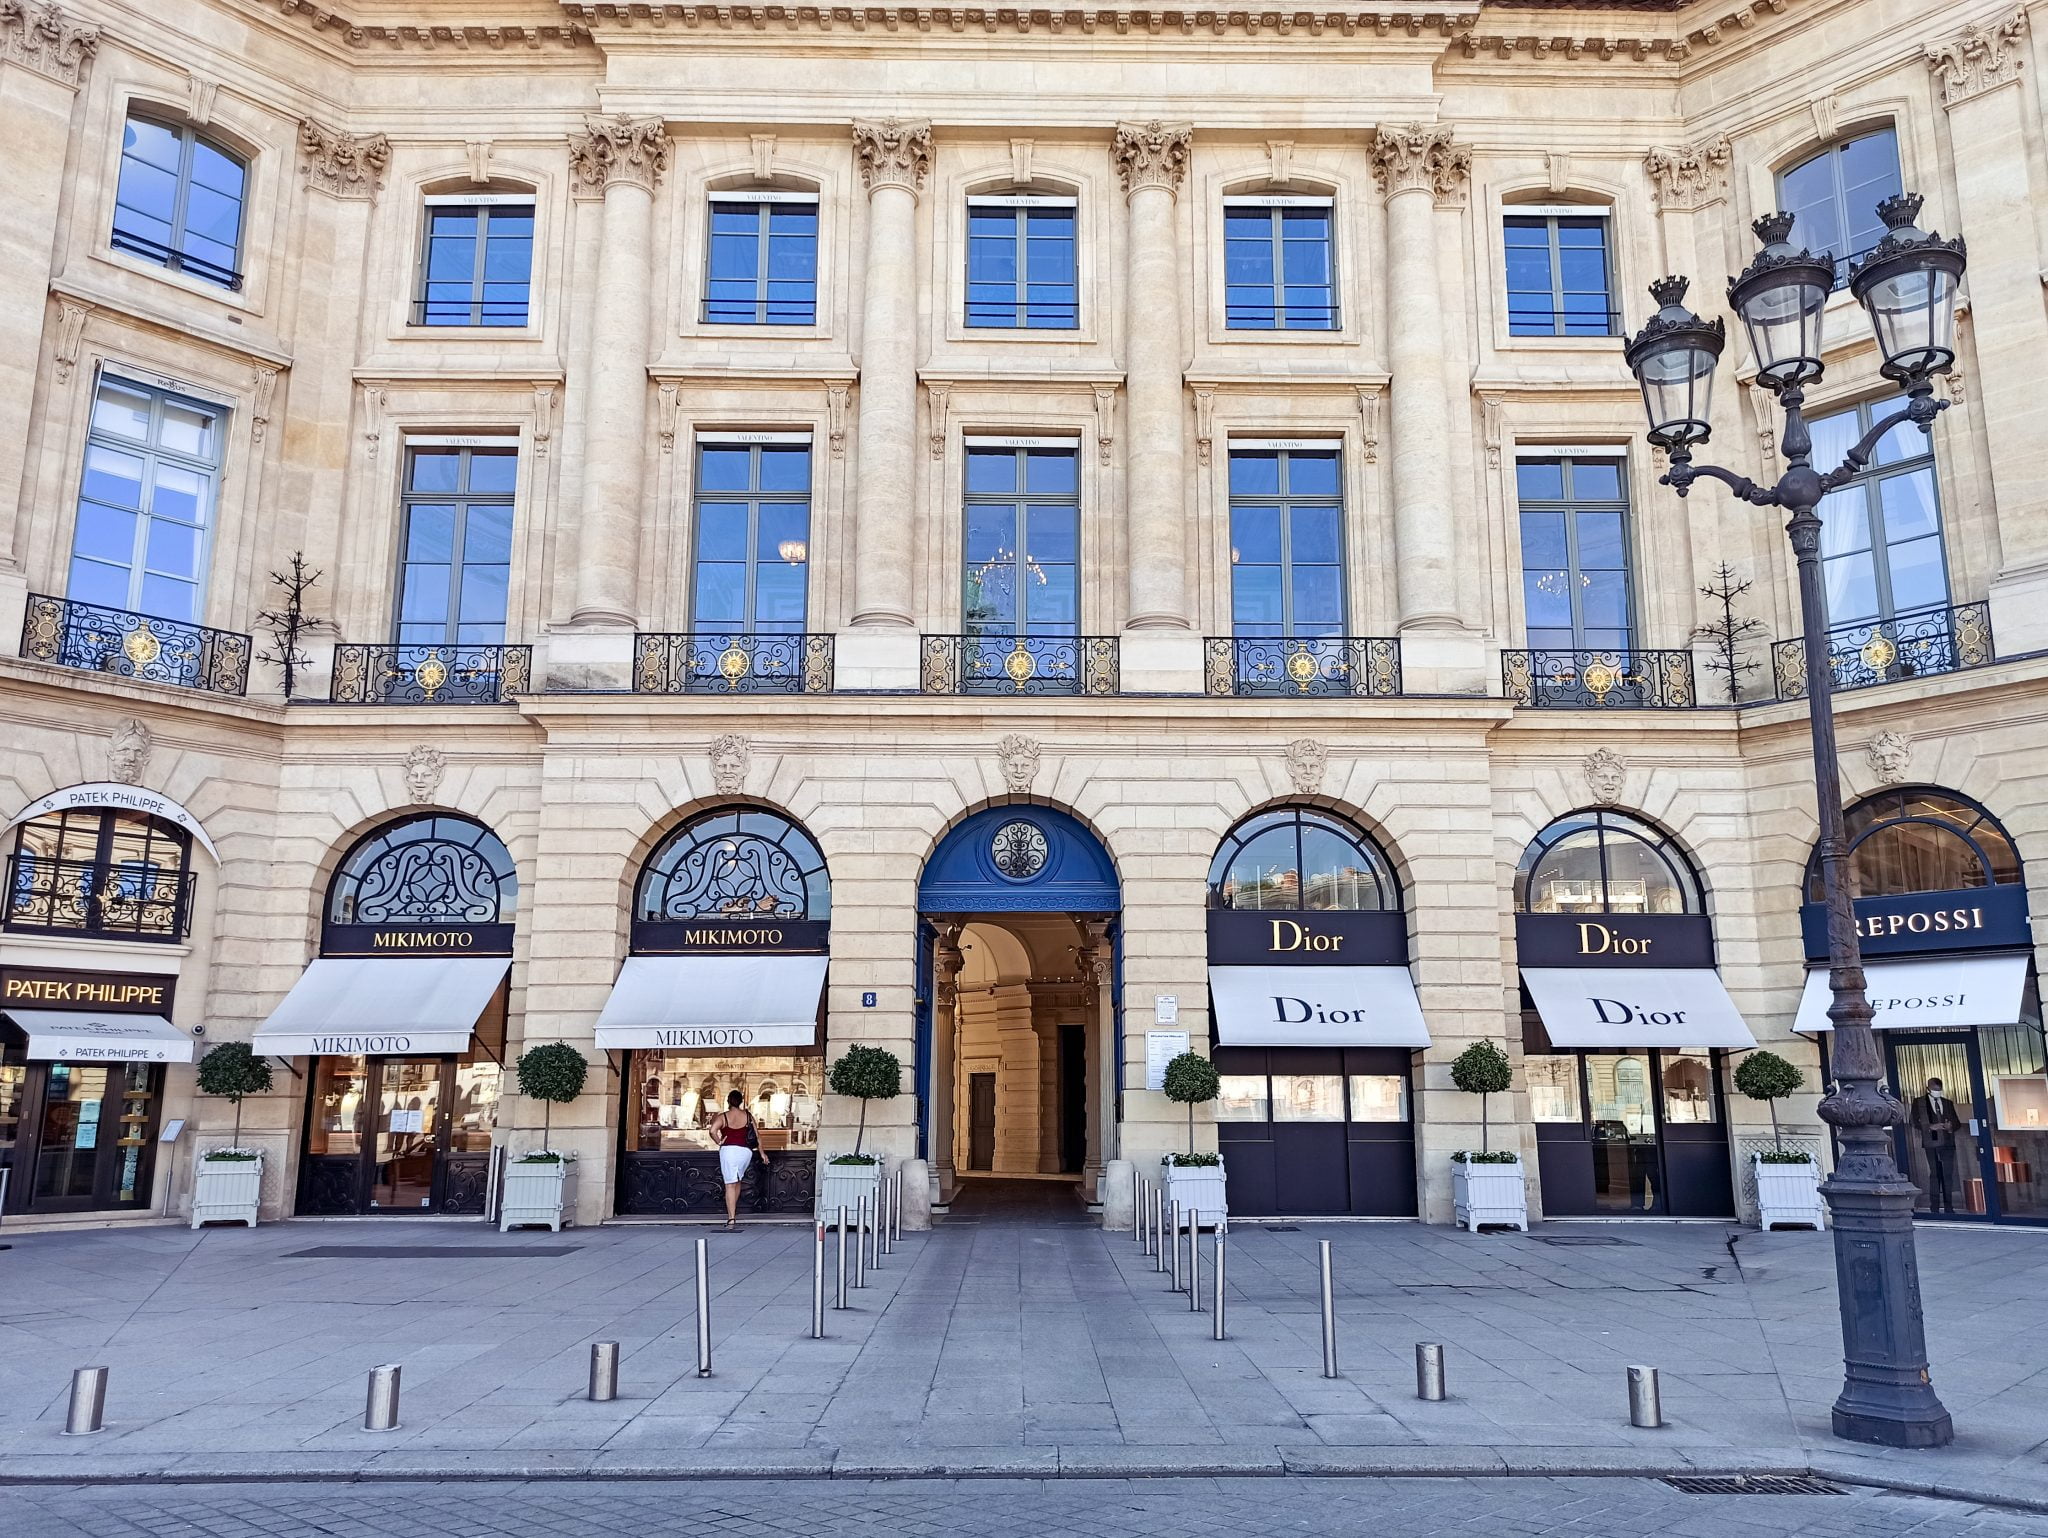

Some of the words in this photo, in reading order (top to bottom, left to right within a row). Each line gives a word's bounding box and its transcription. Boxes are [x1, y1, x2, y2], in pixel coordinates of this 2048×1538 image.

[69, 792, 109, 804] PATEK
[112, 792, 166, 814] PHILIPPE
[373, 932, 473, 947] MIKIMOTO
[684, 929, 783, 945] MIKIMOTO
[1268, 919, 1344, 951] Dior
[1576, 923, 1652, 954] Dior
[6, 979, 73, 1000] PATEK
[76, 983, 164, 1004] PHILIPPE
[866, 994, 873, 1005] 8
[1269, 996, 1366, 1024] Dior
[1871, 994, 1966, 1010] EPOSSI
[1586, 997, 1687, 1025] Dior
[311, 1037, 411, 1053] MIKIMOTO
[656, 1029, 754, 1046] MIKIMOTO
[75, 1048, 105, 1057] PATEK
[107, 1049, 149, 1058] PHILIPPE
